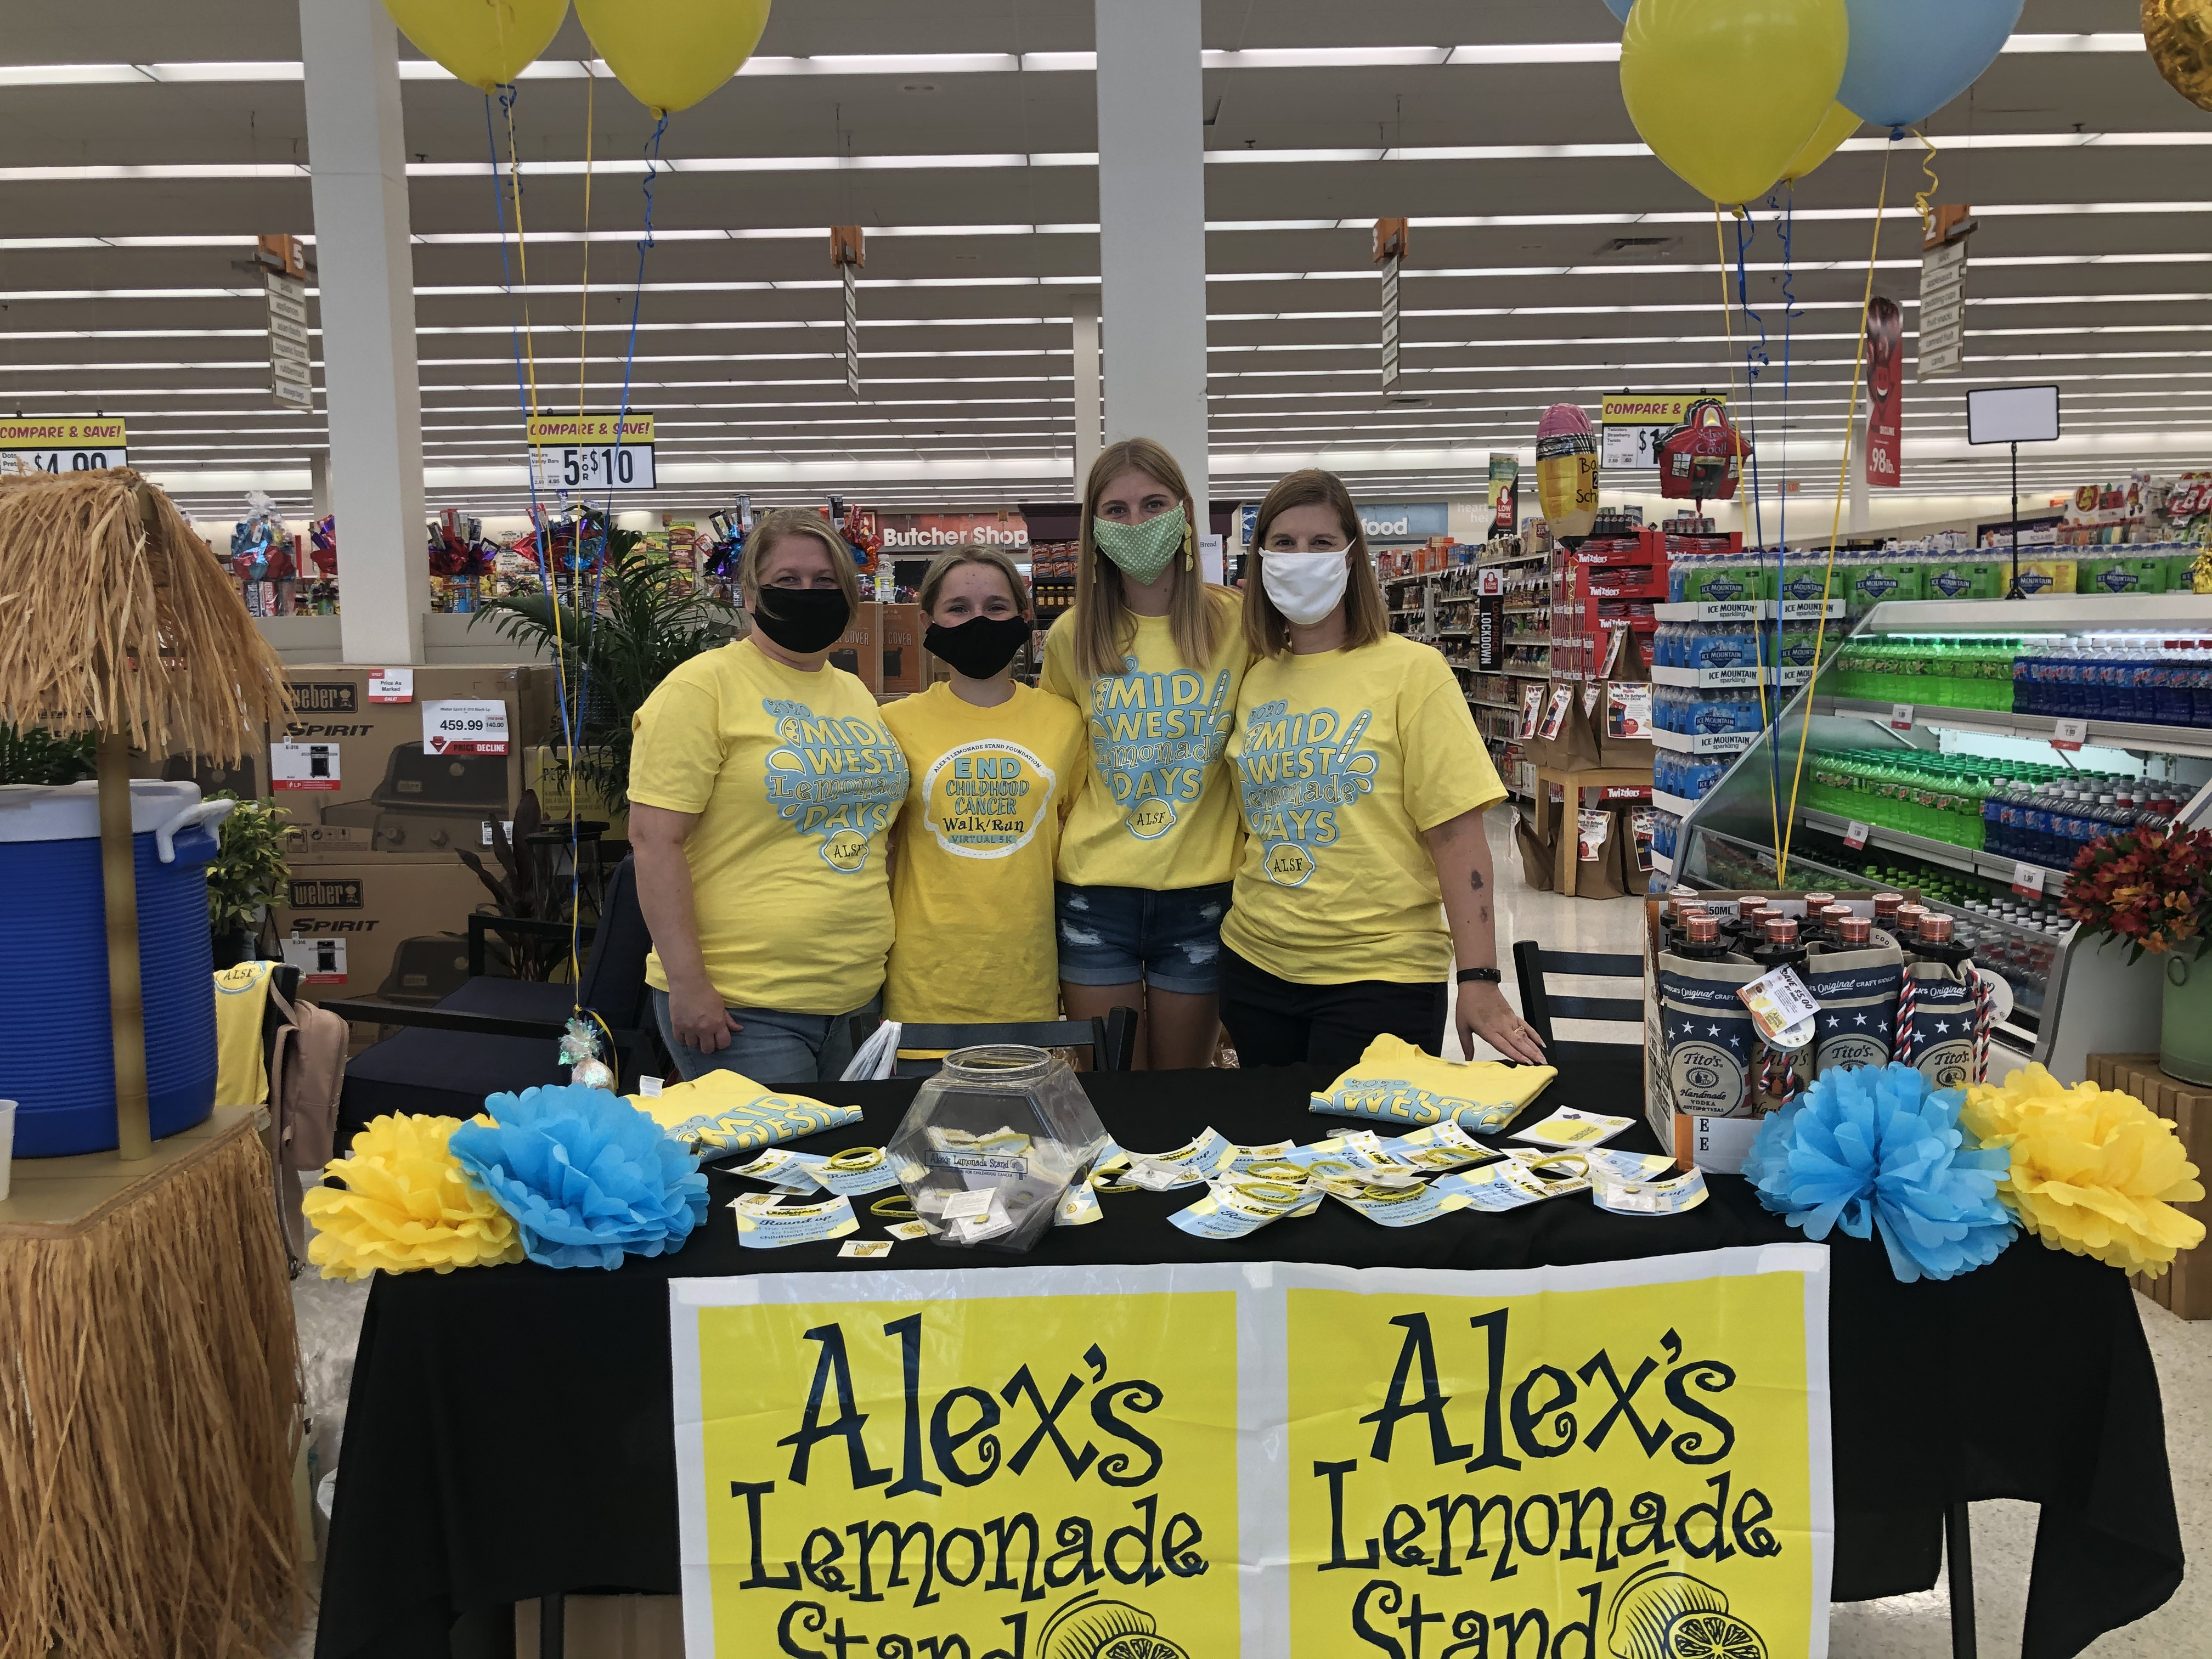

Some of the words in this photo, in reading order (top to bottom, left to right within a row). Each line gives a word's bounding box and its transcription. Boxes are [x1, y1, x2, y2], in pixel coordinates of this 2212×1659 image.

[1926, 215, 1937, 240] 2
[294, 243, 304, 270] 5
[1605, 403, 1669, 415] COMPARE
[1672, 403, 1681, 415] &
[0, 426, 65, 438] COMPARE
[69, 426, 78, 437] &
[83, 425, 121, 438] SAVE!
[530, 423, 595, 435] COMPARE
[599, 423, 608, 435] &
[612, 422, 650, 435] SAVE!
[564, 449, 580, 486] 5
[590, 448, 633, 485] $10
[1578, 458, 1598, 474] Ba
[1576, 489, 1598, 504] Sch
[883, 527, 967, 546] Butcher
[973, 526, 1029, 548] Shop
[1578, 553, 1608, 563] Twizzlers
[1589, 586, 1620, 596] Twizzlers
[1481, 612, 1492, 664] LOCKDOWN
[1720, 670, 1757, 679] MOUNTAIN
[1107, 673, 1201, 710] MID
[440, 720, 483, 731] 459.99
[800, 718, 878, 746] MID
[1104, 708, 1207, 743] WEST
[1252, 712, 1336, 752] MID
[476, 744, 505, 752] DECLINE
[1701, 738, 1712, 747] ICE
[1713, 736, 1751, 745] MOUNTAIN
[934, 757, 951, 773] ALEX'S
[950, 744, 984, 758] LEMONADE
[1006, 745, 1041, 769] FOUNDATION
[1096, 733, 1221, 770] Lemonade
[803, 748, 895, 776] WEST
[954, 757, 1022, 780] END
[1247, 747, 1338, 786] WEST
[946, 780, 1030, 797] CHILDHOOD
[1112, 766, 1201, 802] DAYS
[1607, 788, 1640, 798] Twizzlers
[955, 797, 1017, 815] CANCER
[802, 801, 889, 832] DAYS
[942, 816, 1024, 833] Walk/Run
[1136, 811, 1166, 826] ALSF
[951, 835, 996, 844] VIRTUAL
[999, 835, 1013, 844] 5K
[833, 843, 865, 859] ALSF
[1273, 857, 1304, 873] ALSF
[294, 881, 343, 905] weber
[290, 918, 380, 932] SPIRIT
[1875, 934, 1890, 946] COO
[1681, 988, 1715, 1000] Original
[1818, 979, 1855, 995] Original
[1856, 979, 1877, 988] CRAFT
[1930, 986, 1966, 999] Original
[1684, 1051, 1721, 1067] Tito's
[1832, 1044, 1871, 1059] Tito's
[1934, 1050, 1968, 1065] Tito's
[1680, 1088, 1726, 1101] Handmade
[1700, 1118, 1709, 1132] E
[1700, 1137, 1709, 1151] E
[930, 1153, 951, 1165] Alex's
[953, 1155, 988, 1167] Lemonade
[990, 1158, 1009, 1169] Stand
[759, 1217, 812, 1226] Round
[1359, 1307, 1738, 1474] Alex's
[776, 1311, 1164, 1498] Alex's
[1314, 1458, 1782, 1582] Lemonade
[730, 1492, 1210, 1609] Lemonade
